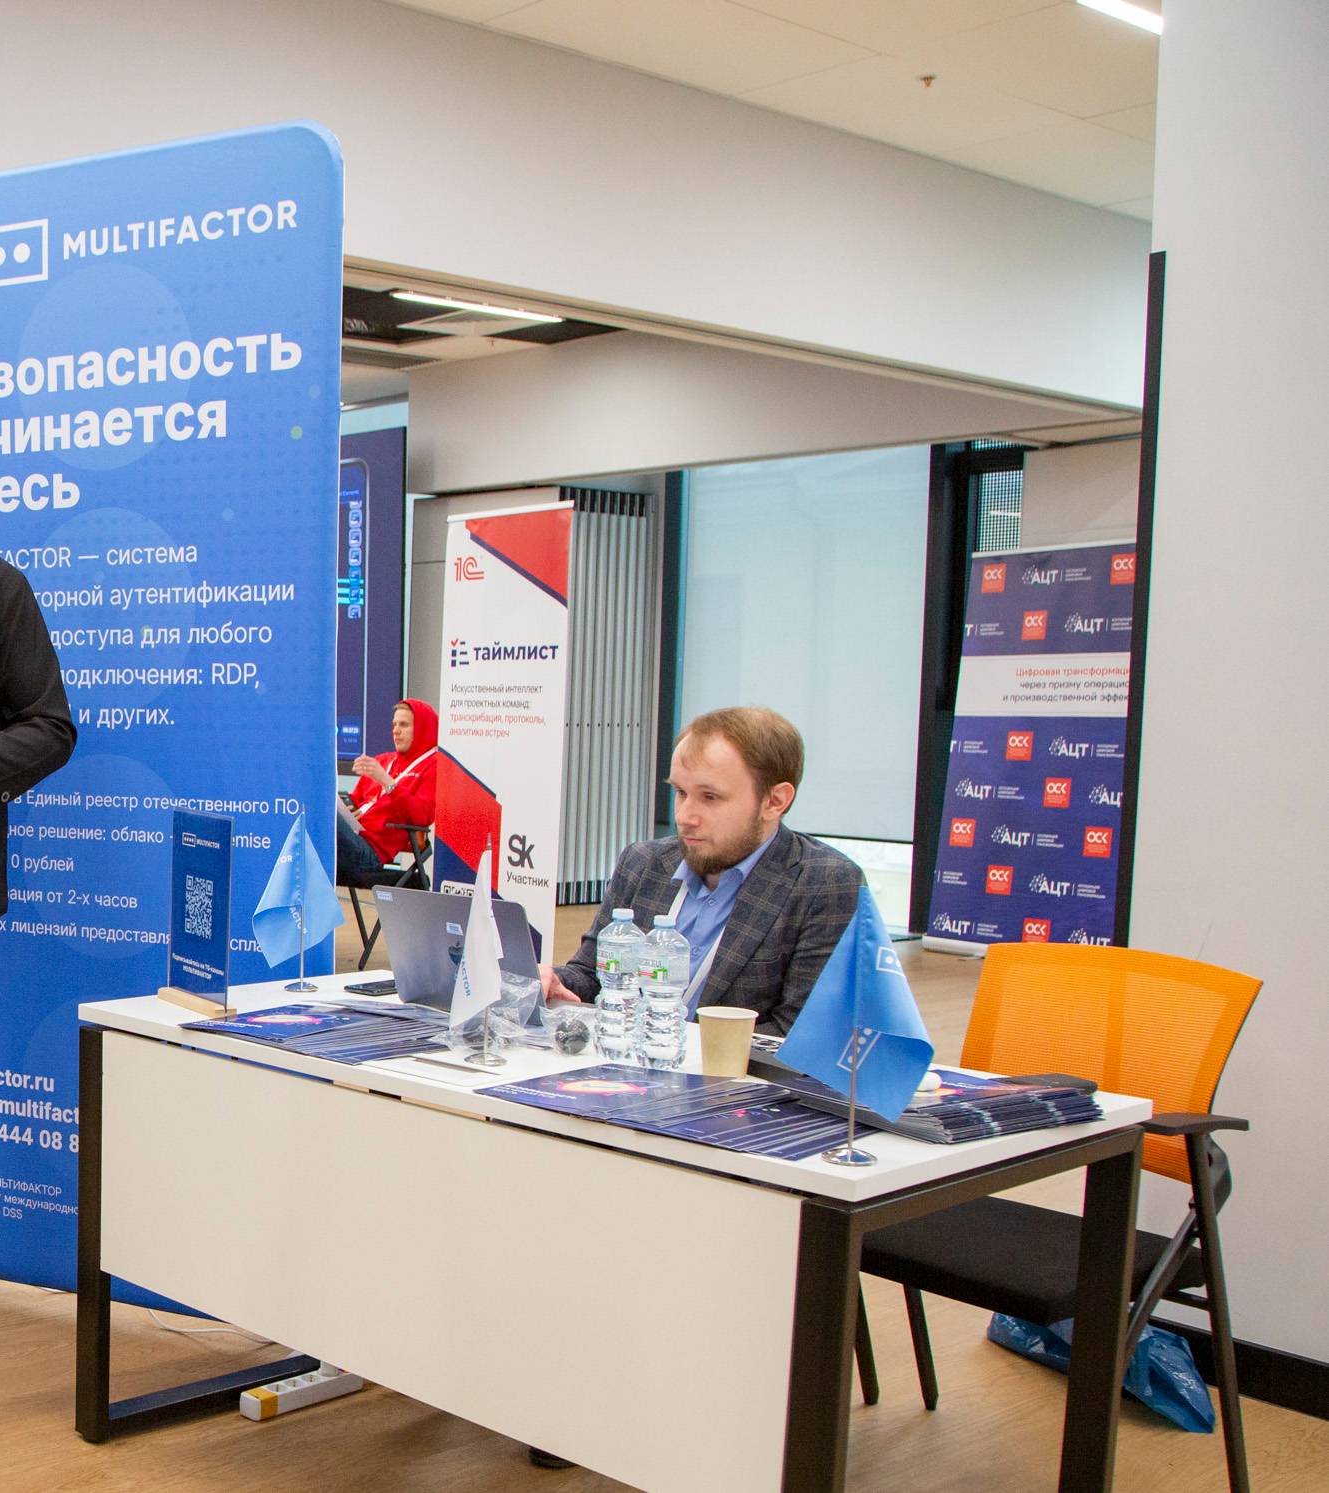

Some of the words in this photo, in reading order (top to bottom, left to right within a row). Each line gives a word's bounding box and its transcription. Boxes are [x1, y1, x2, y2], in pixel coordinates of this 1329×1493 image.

[63, 200, 297, 260] MULTIFACTOR
[106, 543, 198, 566] система
[110, 581, 295, 608] аутентификации
[51, 627, 133, 651] доступа
[140, 624, 180, 649] для
[187, 622, 272, 645] любого
[473, 641, 559, 661] таймлист
[211, 662, 260, 689] RDP,
[1015, 667, 1061, 677] Цифровая
[1020, 680, 1046, 690] через
[1048, 680, 1081, 690] призму
[78, 708, 90, 724] и
[97, 705, 175, 730] других.
[26, 789, 81, 807] Единый
[85, 795, 139, 812] реестр
[143, 796, 269, 814] отечественного
[275, 798, 299, 815] ПО
[7, 824, 34, 839] ное
[39, 826, 106, 841] решение:
[111, 827, 164, 844] облако
[507, 833, 535, 869] Sk
[24, 856, 74, 873] рублей
[506, 871, 549, 888] Участник
[8, 888, 42, 905] ация
[47, 891, 63, 903] от
[68, 889, 90, 905] 2-х
[94, 894, 138, 909] часов
[11, 920, 77, 937] лицензий
[39, 1129, 63, 1150] 08
[3, 1207, 23, 1220] DSS
